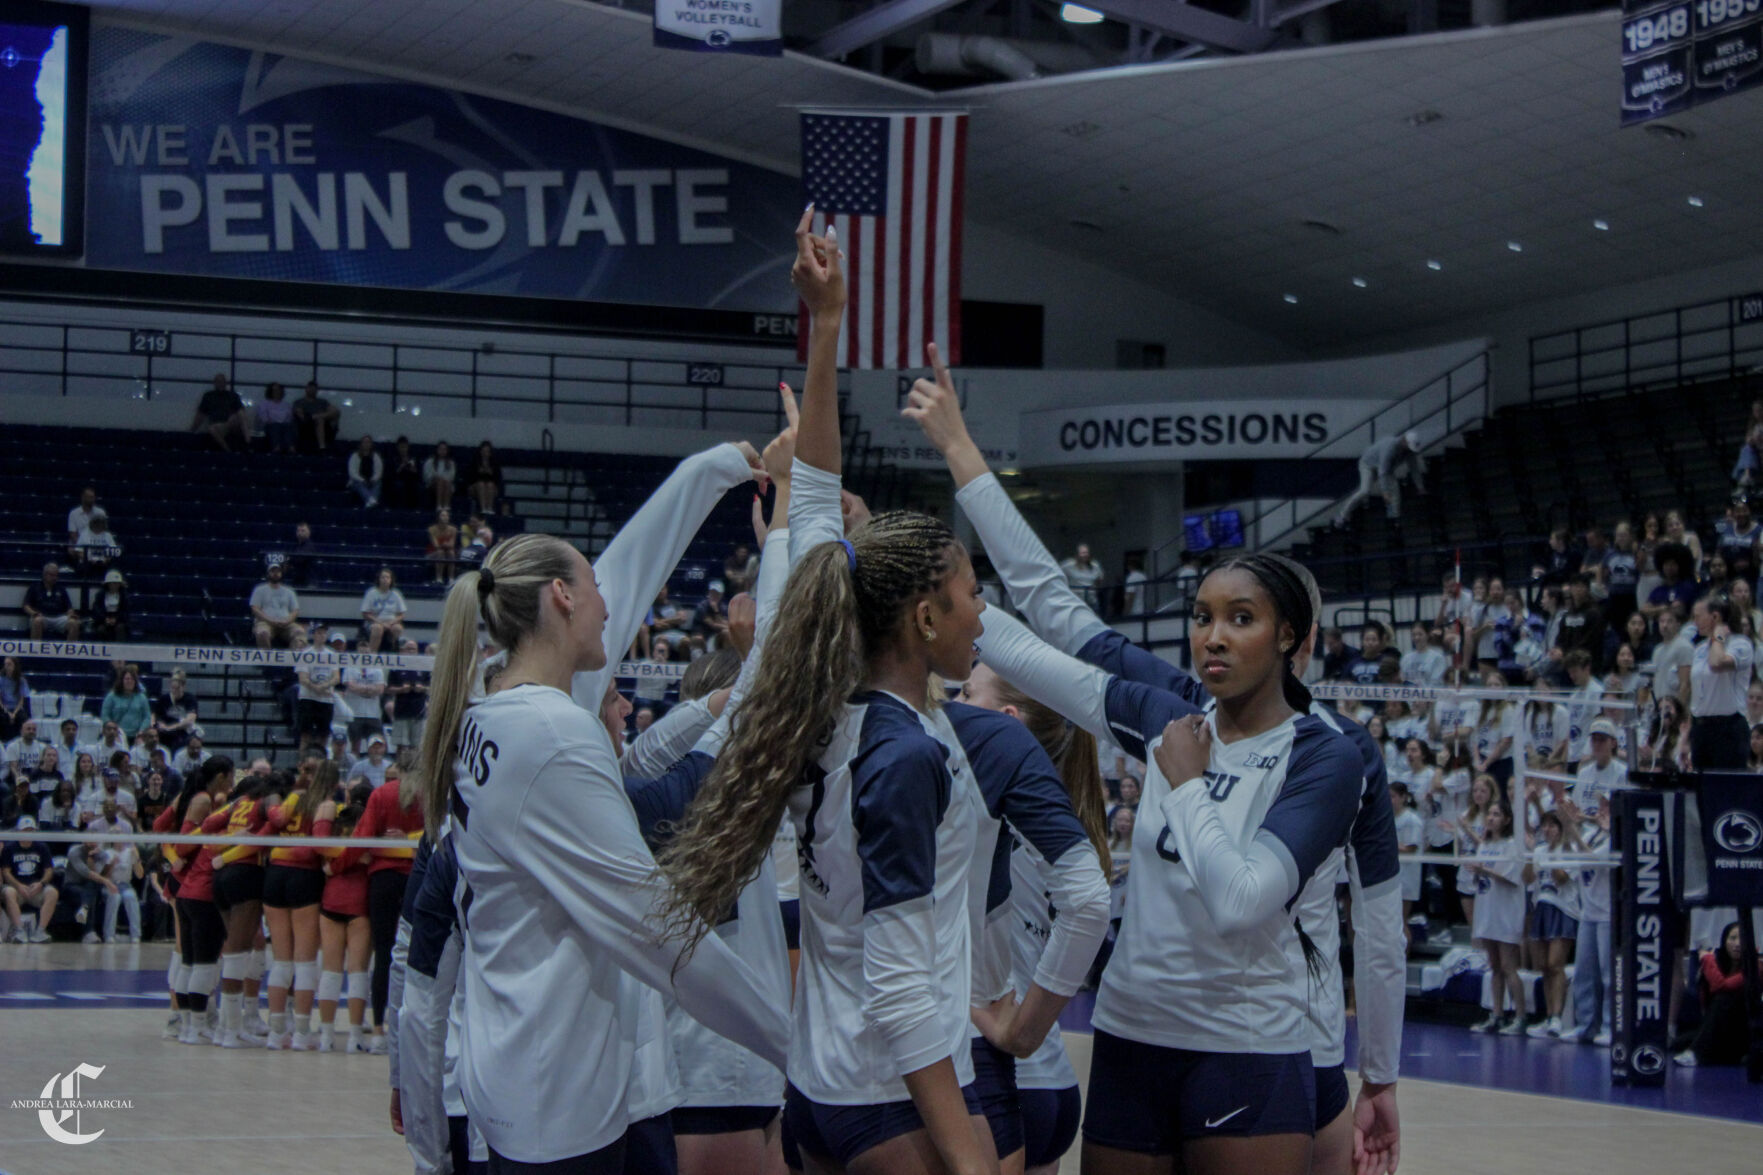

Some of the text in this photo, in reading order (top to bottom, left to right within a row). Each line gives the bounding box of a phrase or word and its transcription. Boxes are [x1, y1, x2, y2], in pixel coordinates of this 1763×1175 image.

[675, 11, 763, 28] VOLLEYBALL
[1625, 8, 1688, 51] 1948
[103, 123, 317, 166] WE ARE
[140, 168, 735, 254] PENN STATE
[1743, 299, 1763, 319] 201
[135, 335, 167, 351] 219
[691, 367, 721, 383] 220
[1060, 413, 1329, 451] CONCESSIONS
[105, 547, 121, 557] 119
[267, 553, 285, 564] 120
[174, 647, 406, 667] PENN STATE VOLLEYBALL
[613, 663, 683, 676] EYBALL
[1344, 686, 1438, 699] VOLLEYBALL
[230, 800, 255, 824] 22
[1715, 858, 1763, 870] PENN STATE
[1636, 809, 1661, 1020] PENN STATE
[1615, 956, 1624, 1032] PENN STATE
